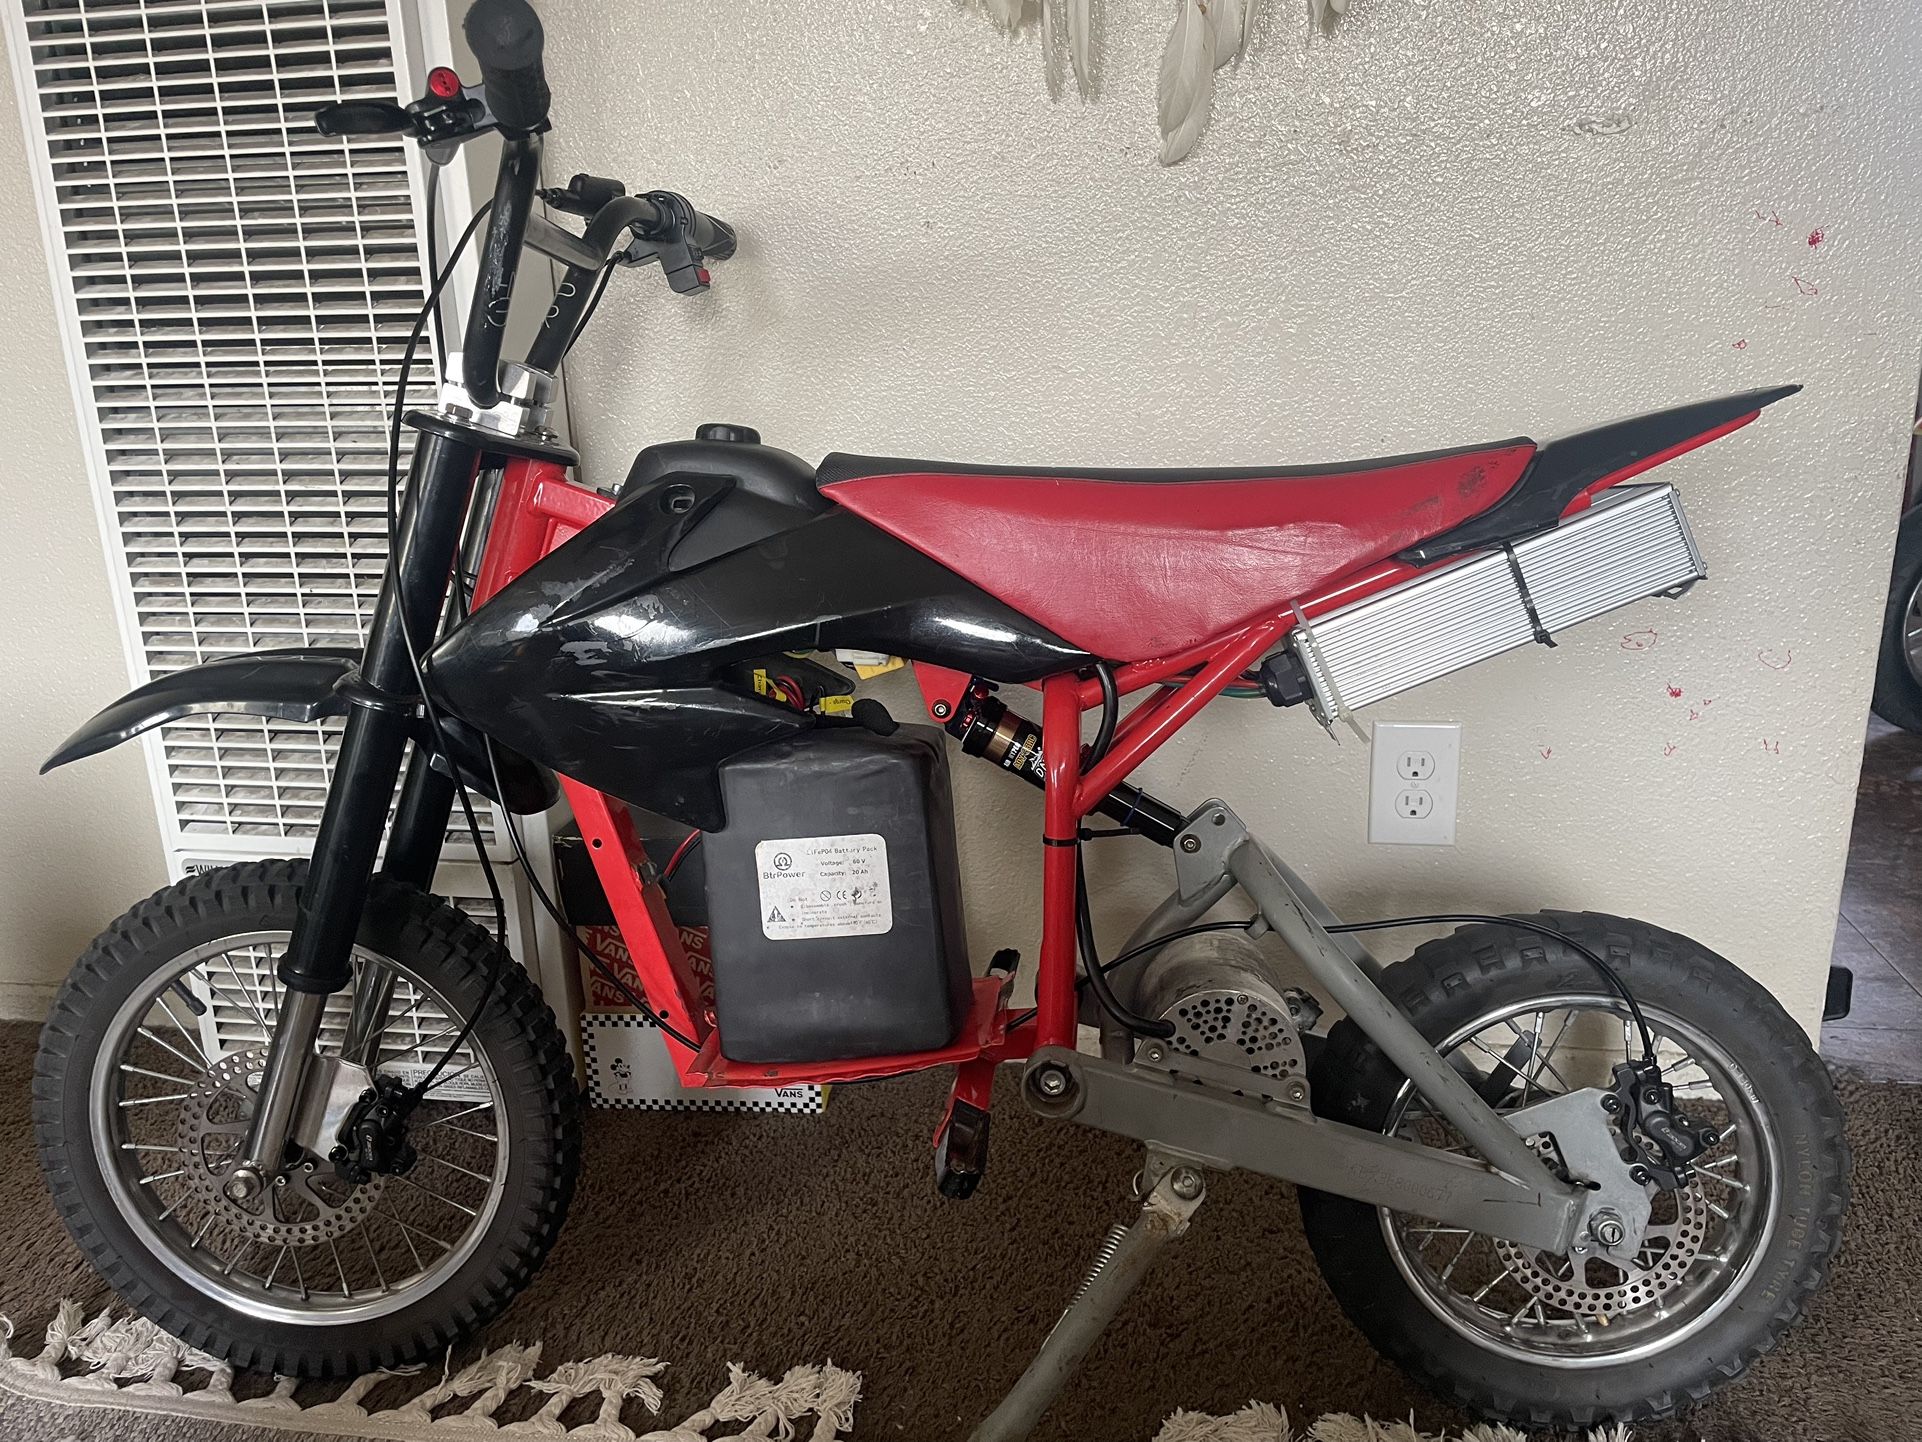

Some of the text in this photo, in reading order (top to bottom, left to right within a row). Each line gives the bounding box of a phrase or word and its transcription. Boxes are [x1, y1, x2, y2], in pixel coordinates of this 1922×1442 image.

[762, 871, 806, 880] BtrPower
[596, 933, 634, 965] VAN
[591, 976, 625, 1003] ANS
[774, 1088, 803, 1098] VANS
